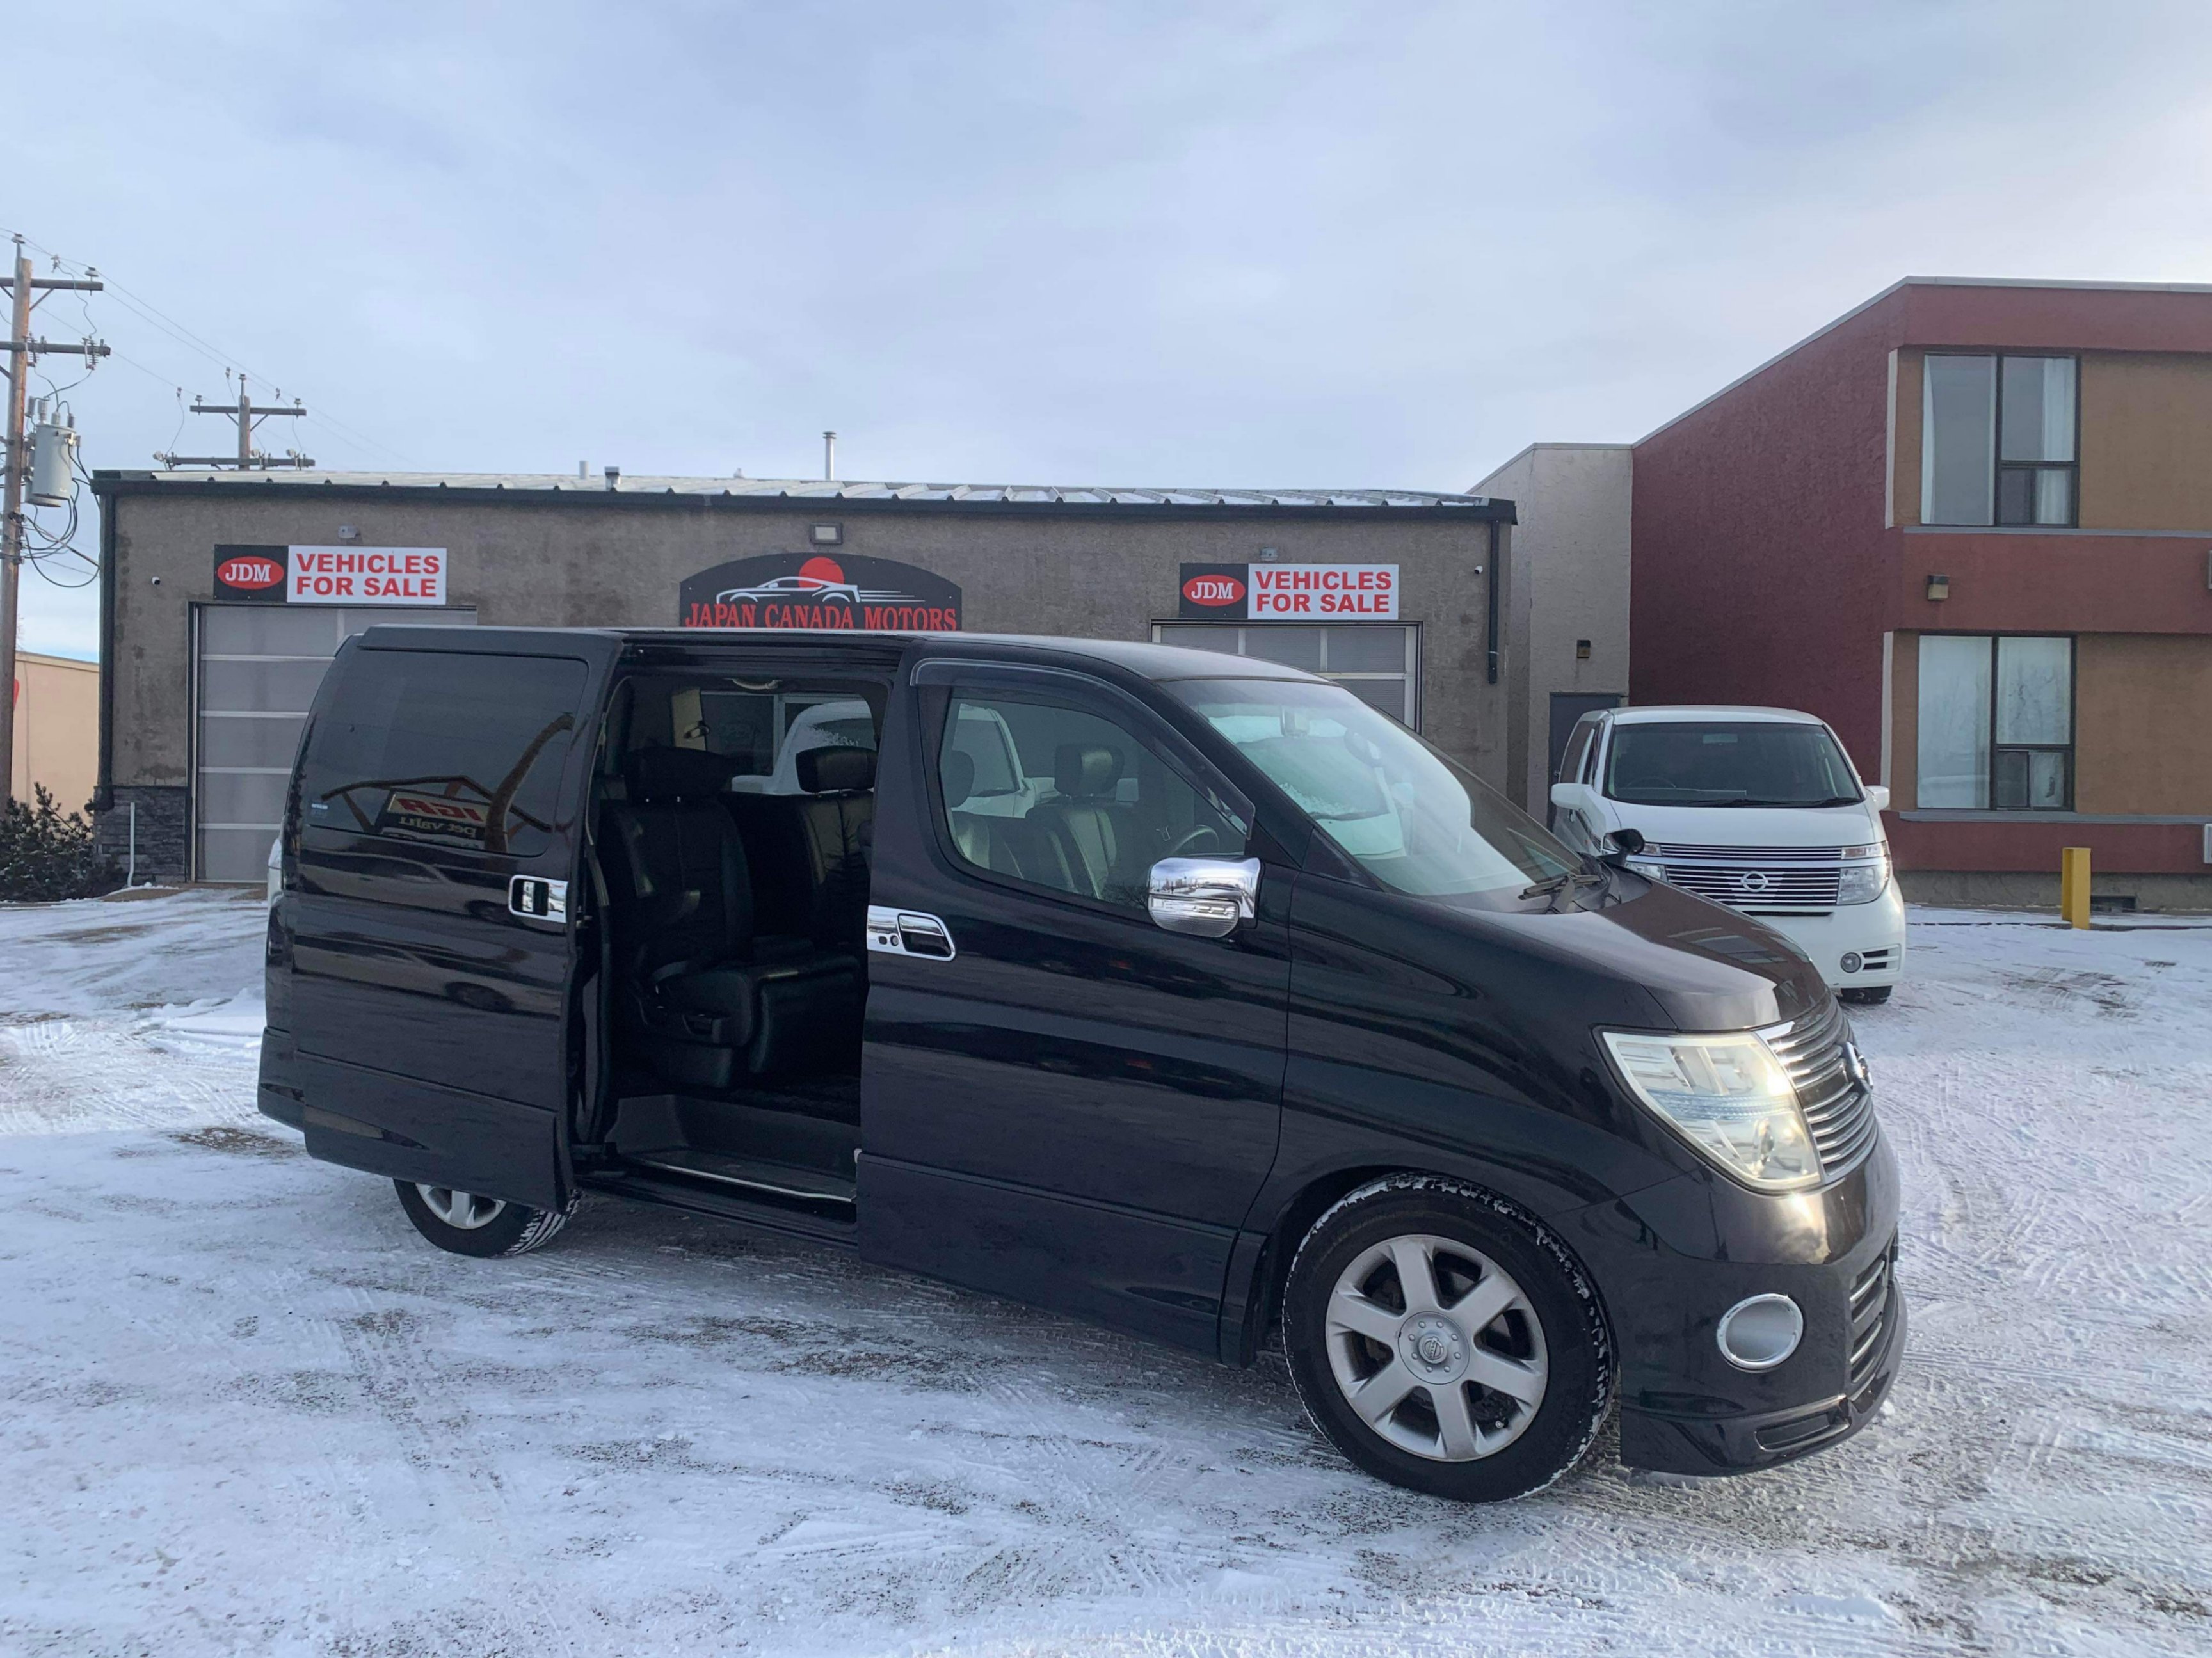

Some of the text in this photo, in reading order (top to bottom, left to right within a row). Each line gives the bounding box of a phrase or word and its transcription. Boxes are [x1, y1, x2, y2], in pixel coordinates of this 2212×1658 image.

[225, 563, 271, 582] JDM
[296, 553, 440, 574] VEHICLES
[296, 577, 437, 597] FOR SALE
[1191, 582, 1234, 600] JDM
[1255, 571, 1392, 591] VEHICLES
[1256, 593, 1390, 613] FOR SALE
[685, 603, 958, 631] JAPAN CANADA MOTORS
